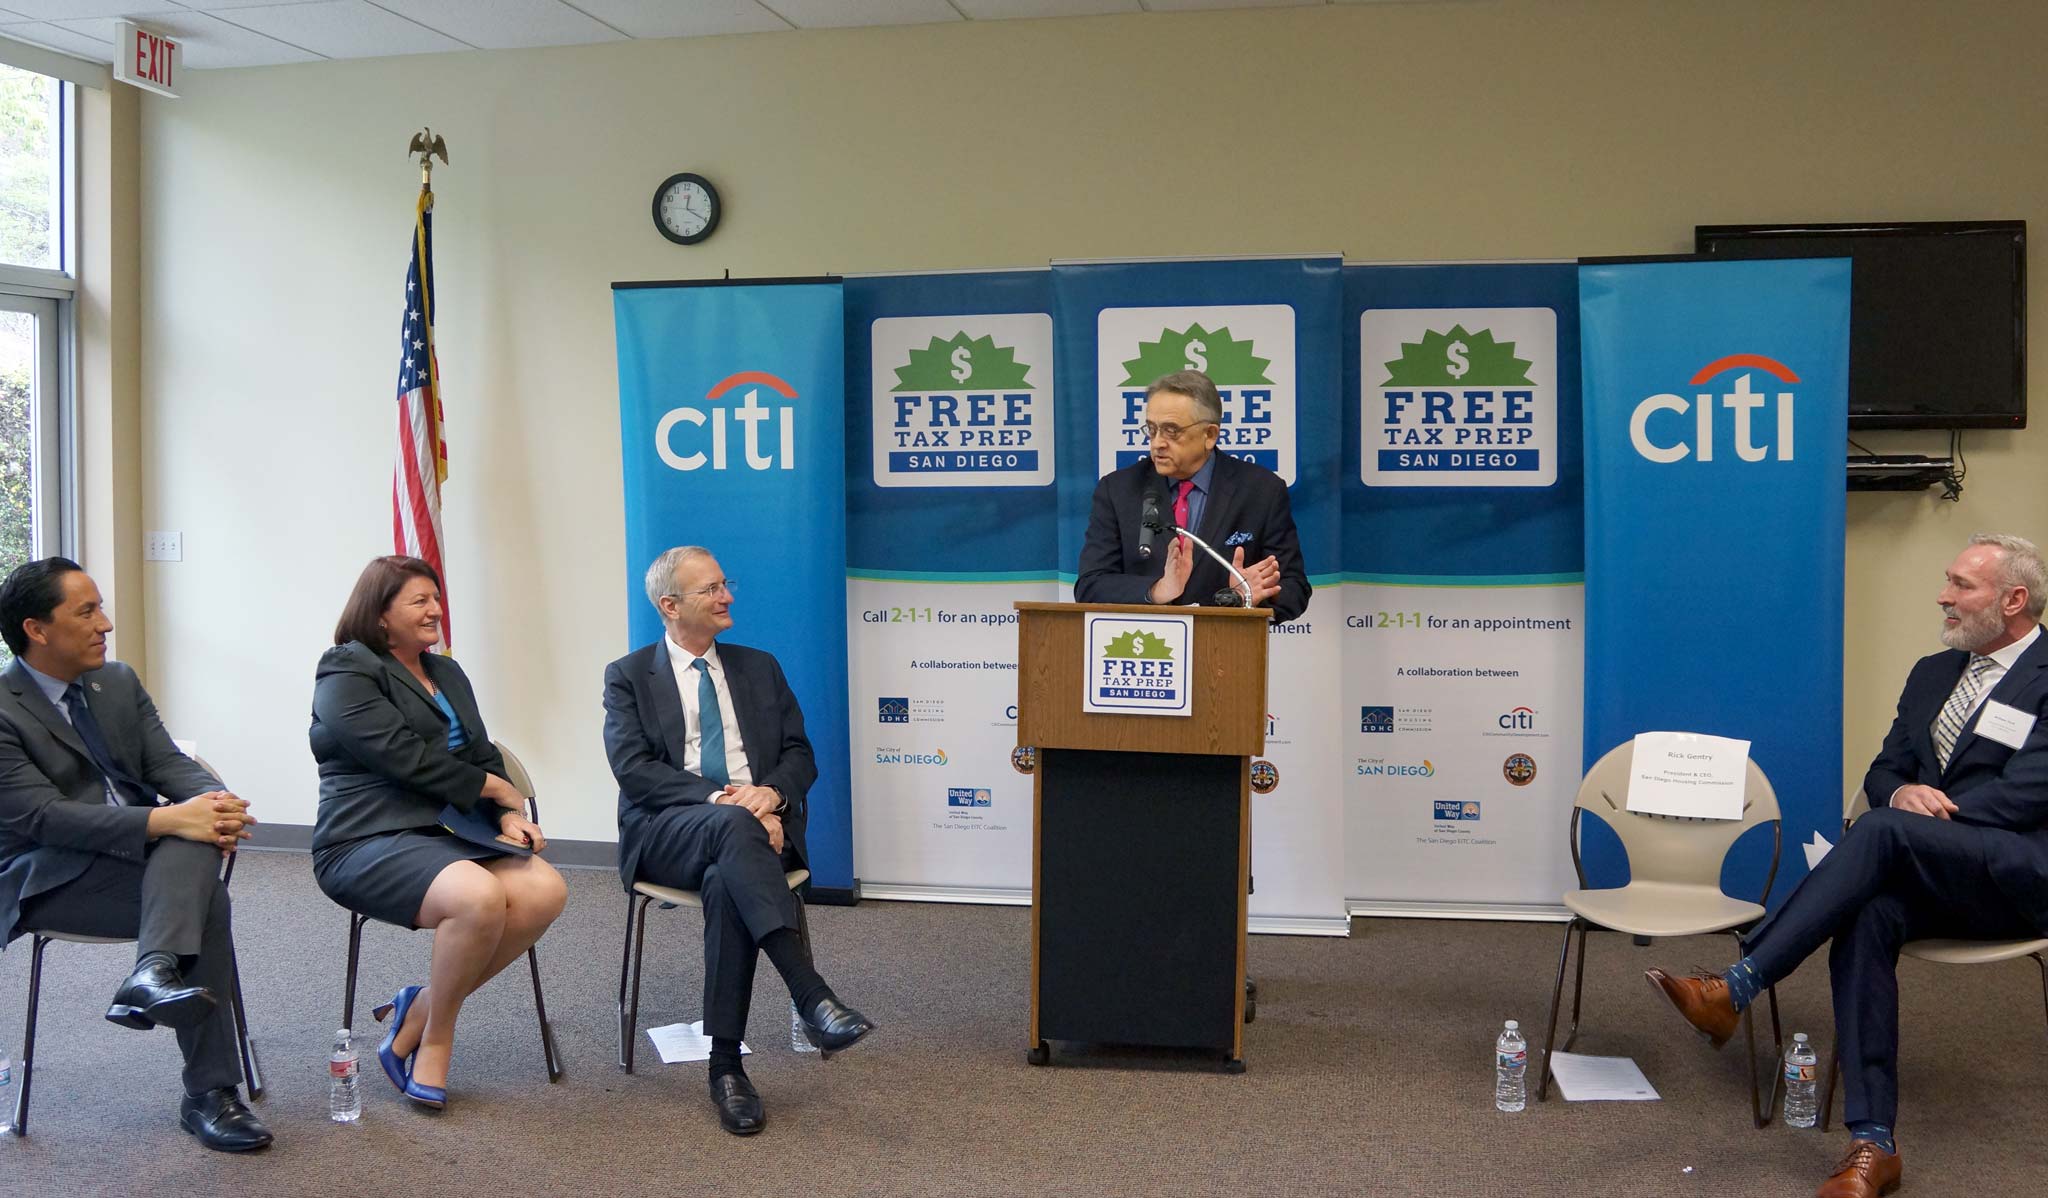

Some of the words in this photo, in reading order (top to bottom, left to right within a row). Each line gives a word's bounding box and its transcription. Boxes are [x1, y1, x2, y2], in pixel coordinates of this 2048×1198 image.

[136, 30, 175, 87] EXIT
[893, 393, 1032, 428] FREE
[1121, 389, 1272, 425] FE
[1384, 390, 1533, 425] FREE
[1629, 372, 1794, 463] citi
[655, 388, 794, 471] citi
[1216, 427, 1272, 446] REP
[1383, 427, 1444, 445] TAX
[1454, 427, 1534, 445] PREP
[894, 430, 950, 448] TAX
[959, 429, 1032, 447] PREP
[908, 455, 946, 469] SAN
[956, 454, 1018, 468] DIEGO
[1399, 453, 1440, 467] SAN
[1451, 453, 1518, 467] DIEGO
[862, 610, 888, 623] Call
[890, 607, 933, 623] 2-1-1
[937, 610, 958, 623] for
[960, 613, 977, 624] an
[1346, 615, 1374, 628] Call
[1377, 612, 1422, 629] 2-1-1
[1427, 615, 1449, 628] for
[1451, 618, 1470, 629] an
[1474, 616, 1572, 632] appointment
[910, 660, 918, 669] A
[919, 660, 981, 670] collaboration
[983, 660, 1019, 670] betwee
[1102, 659, 1174, 678] FREE
[1396, 667, 1405, 676] A
[1406, 667, 1473, 677] collaboration
[1475, 668, 1519, 677] between
[1102, 676, 1131, 686] TAX
[1136, 678, 1173, 687] PREP
[1109, 689, 1129, 697] SAN
[1133, 690, 1166, 698] DIEGO
[1498, 711, 1533, 729] citi
[876, 754, 901, 764] SAN
[904, 754, 942, 765] DIEGO
[1667, 751, 1684, 759] Rick
[1686, 752, 1713, 761] Gentry
[1357, 765, 1384, 775] SAN
[1387, 765, 1429, 776] DIEGO
[949, 789, 973, 798] United
[958, 796, 973, 806] Way
[1435, 802, 1460, 810] United
[1444, 809, 1460, 820] Way
